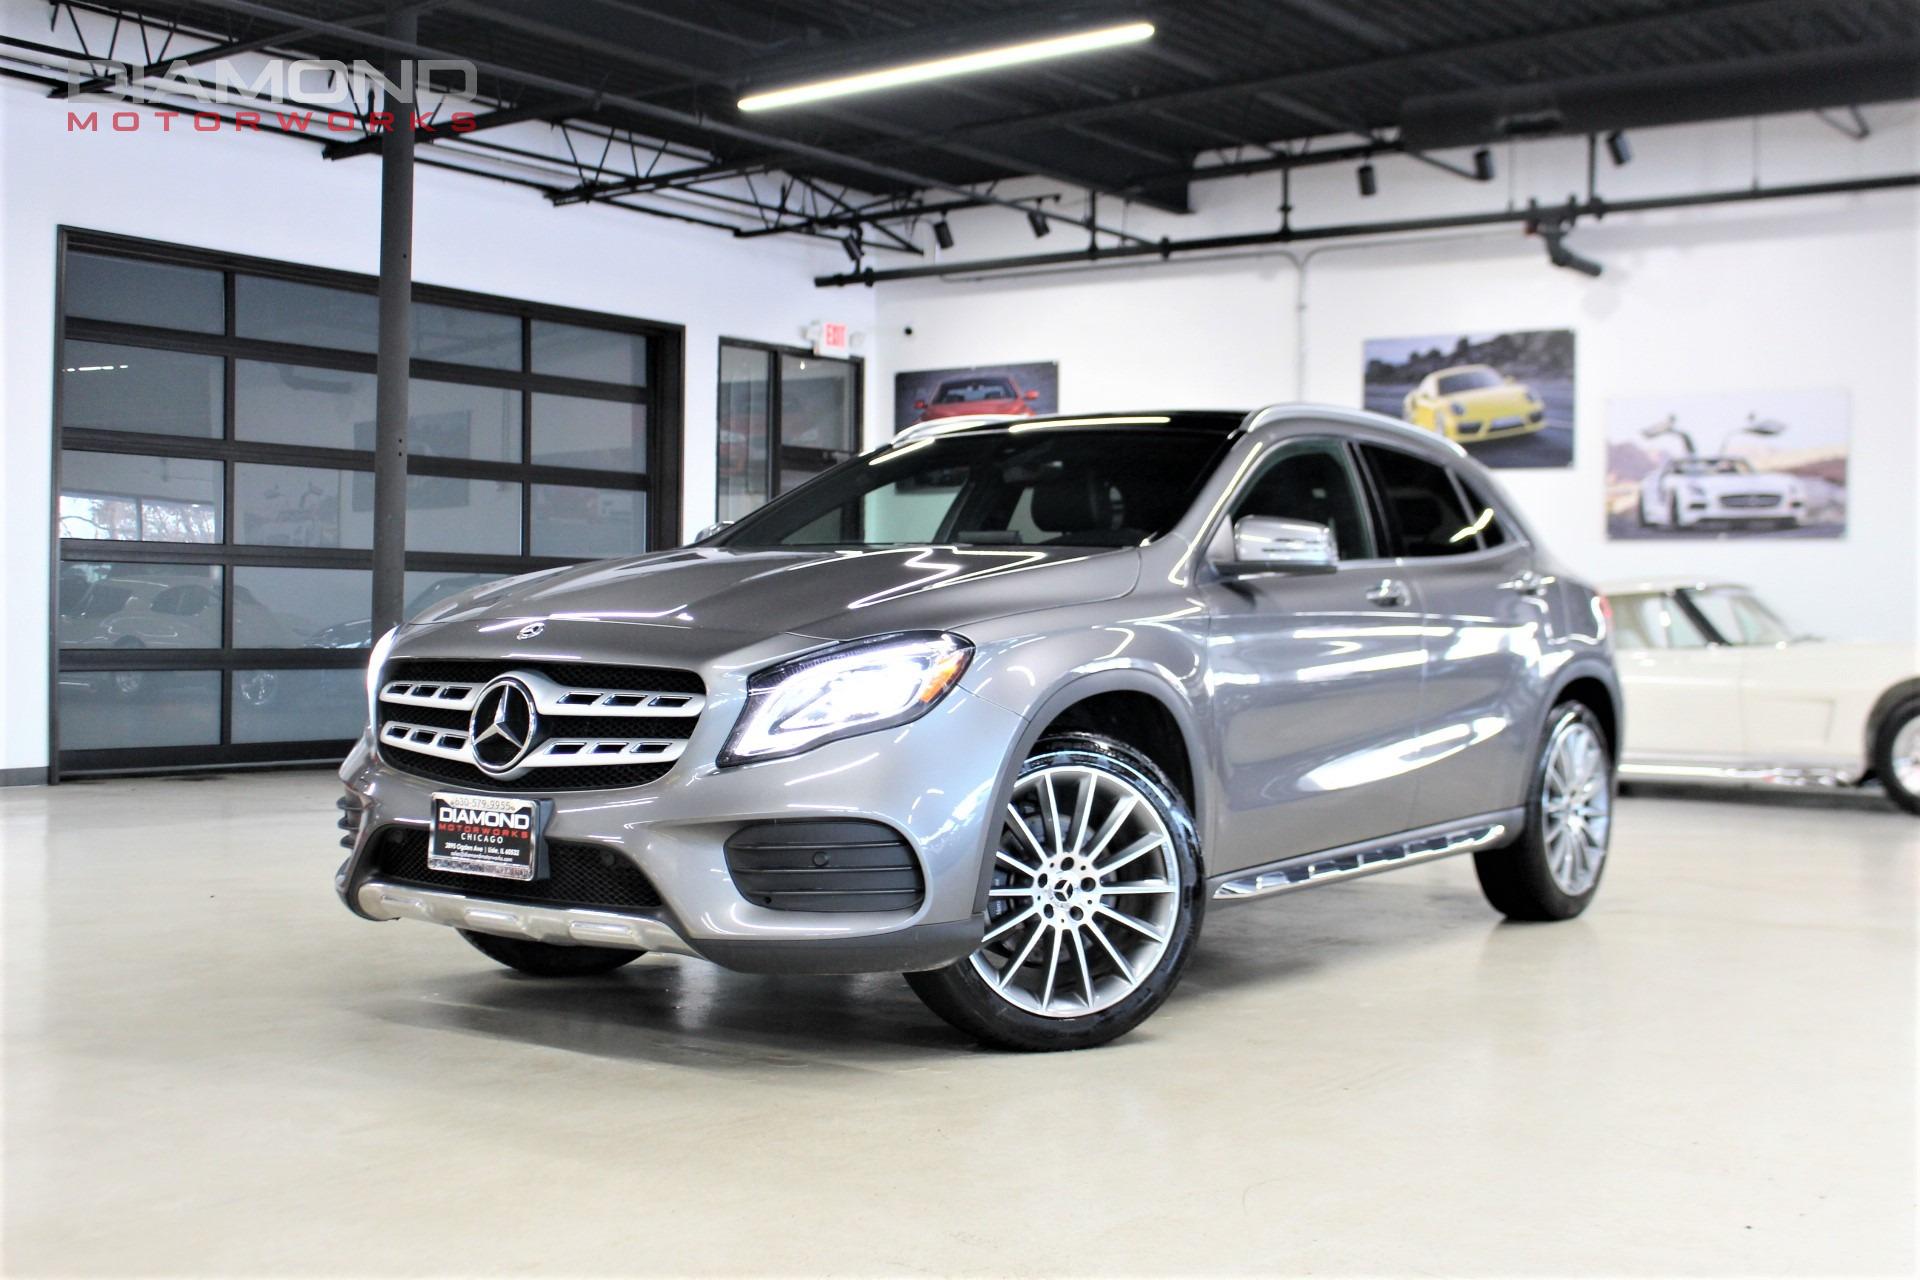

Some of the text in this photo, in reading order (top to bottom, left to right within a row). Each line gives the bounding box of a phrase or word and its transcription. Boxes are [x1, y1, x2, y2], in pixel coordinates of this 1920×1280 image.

[826, 323, 845, 347] EXIT
[439, 807, 530, 829] DIAMOND
[438, 823, 529, 839] MOTORWORKS
[460, 832, 504, 844] CHICAGO
